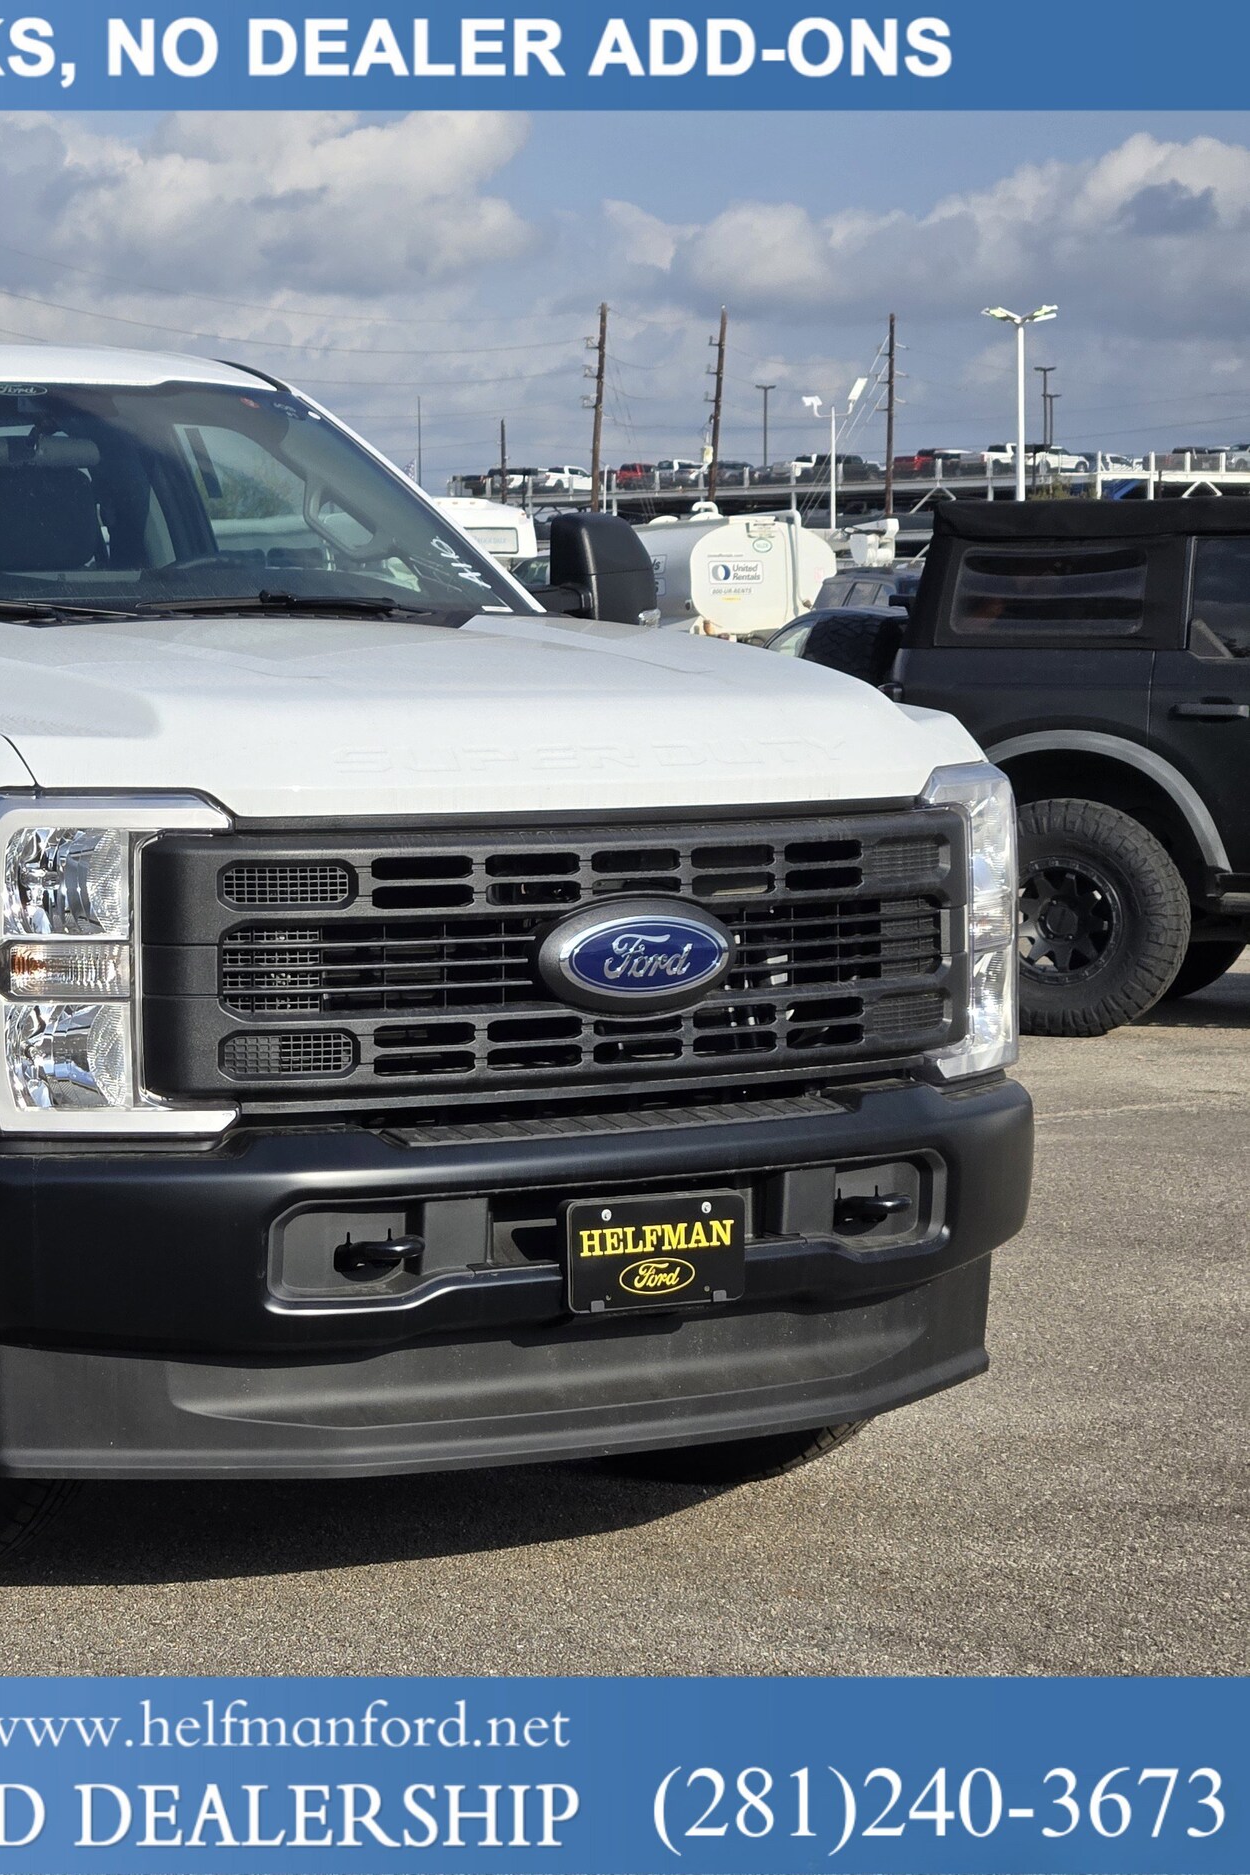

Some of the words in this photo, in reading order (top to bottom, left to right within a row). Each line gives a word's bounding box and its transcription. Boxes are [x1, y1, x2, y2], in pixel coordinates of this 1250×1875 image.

[732, 563, 758, 572] United
[732, 573, 760, 581] Rentals
[333, 740, 640, 774] SUPER
[652, 735, 847, 766] DUTY
[603, 932, 694, 980] Ford
[579, 1219, 735, 1258] HELFMAN
[633, 1261, 681, 1288] Ford
